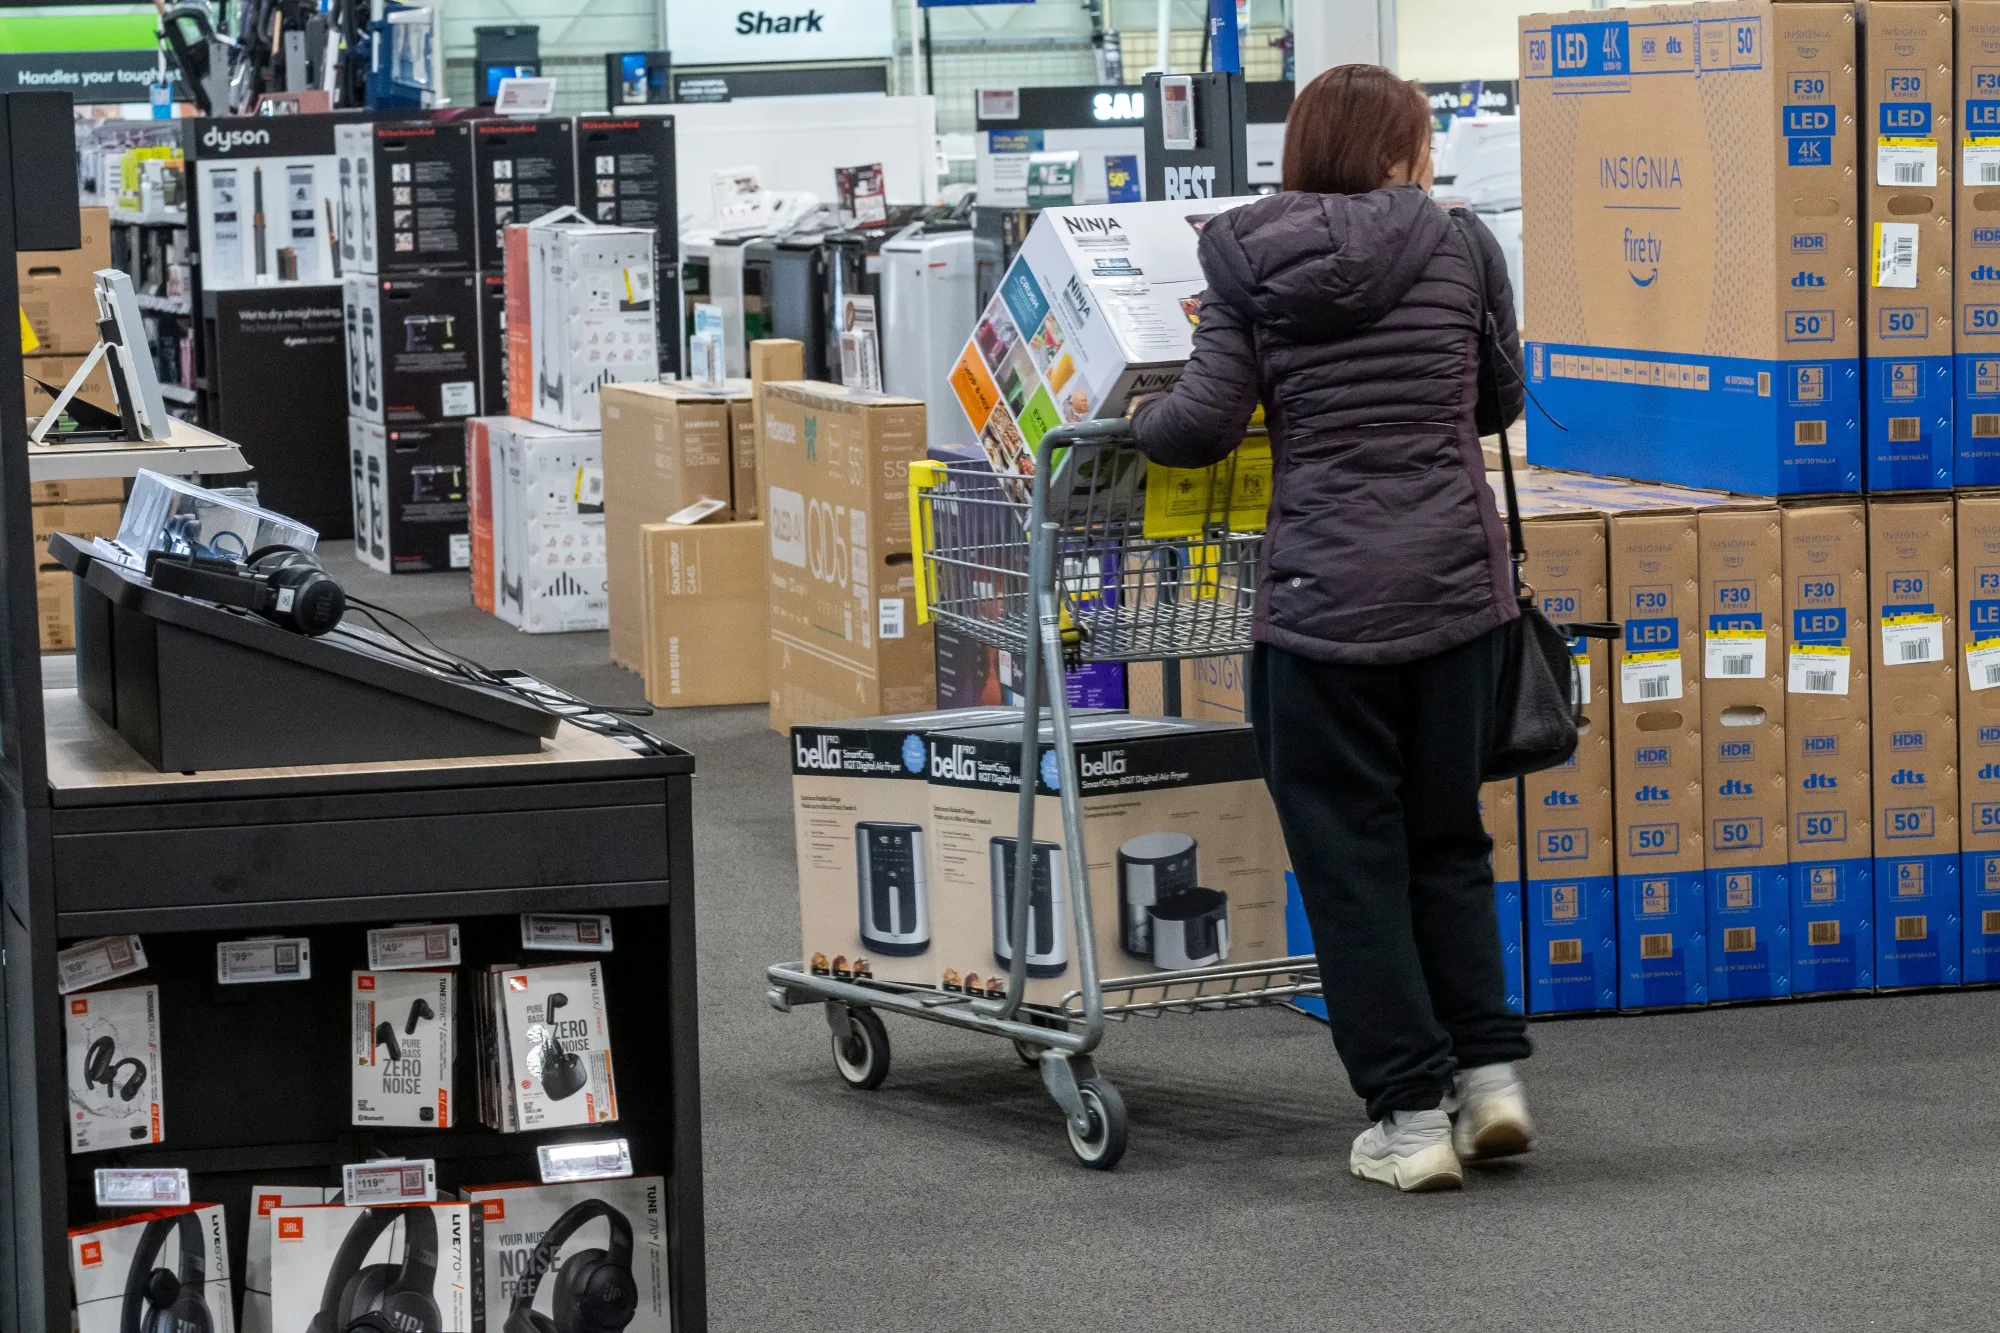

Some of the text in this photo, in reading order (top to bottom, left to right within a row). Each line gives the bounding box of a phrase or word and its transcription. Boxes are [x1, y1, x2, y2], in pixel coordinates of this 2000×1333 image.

[736, 9, 824, 35] Shark
[1968, 25, 2000, 34] INSIG
[1784, 30, 1832, 39] INSIGNIA
[1881, 28, 1928, 38] INSIGNIA
[1529, 39, 1547, 60] F30
[1557, 32, 1588, 69] LED
[1602, 28, 1621, 59] 4K
[1666, 36, 1683, 53] dts
[18, 68, 183, 87] Handles your toughst
[1890, 76, 1921, 91] F30
[1793, 79, 1824, 94] F30
[1477, 89, 1507, 107] ake
[1790, 112, 1829, 130] LED
[1887, 109, 1925, 127] LED
[203, 126, 270, 152] dyson
[1798, 141, 1822, 158] 4K
[1600, 155, 1683, 191] INSIGNIA
[1164, 166, 1216, 200] BEST
[1062, 215, 1122, 236] NINJA
[1793, 235, 1824, 249] HDR
[1791, 271, 1827, 287] dts
[1067, 274, 1091, 319] NINJA
[1800, 369, 1810, 383] 6
[1894, 366, 1904, 380] 6
[1977, 362, 1988, 376] 6
[1800, 386, 1815, 394] MAX
[807, 497, 849, 589] QD5
[1892, 578, 1923, 594] F30
[1980, 573, 2000, 588] F3
[1720, 587, 1751, 603] F30
[1804, 582, 1835, 597] F30
[1543, 597, 1575, 612] F30
[1635, 592, 1667, 608] F30
[1977, 606, 2000, 624] LE
[1801, 615, 1840, 633] LED
[1632, 625, 1672, 644] LED
[669, 637, 680, 695] SAMSUNG
[1191, 655, 1244, 691] INSIGN
[826, 735, 840, 744] PRO
[1892, 733, 1923, 746] HDR
[1979, 727, 2000, 741] HD
[962, 745, 976, 755] PRO
[1720, 743, 1751, 756] HDR
[1804, 737, 1836, 750] HDR
[795, 734, 842, 770] bella
[1636, 748, 1667, 762] HDR
[856, 761, 875, 773] Digital
[876, 763, 884, 771] Air
[884, 763, 901, 774] Fryer
[931, 742, 977, 781] bella
[1080, 751, 1127, 778] bella
[1136, 774, 1158, 785] Digital
[1159, 773, 1170, 782] Air
[1170, 771, 1190, 782] Fryer
[1890, 769, 1926, 785] dts
[1978, 763, 2000, 779] dt
[991, 774, 1011, 785] Digital
[1719, 779, 1753, 796] dts
[1802, 773, 1838, 789] dts
[1543, 790, 1580, 806] dts
[1635, 785, 1670, 801] dts
[1900, 866, 1910, 880] 6
[1987, 859, 1996, 873] 6
[1729, 876, 1739, 891] 6
[1812, 870, 1823, 884] 6
[1554, 888, 1564, 903] 6
[1645, 882, 1655, 897] 6
[590, 967, 600, 1008] TUNE FLEX
[526, 1004, 543, 1013] PURE
[527, 1014, 545, 1023] BASS
[552, 1019, 588, 1039] ZERO
[402, 1038, 421, 1048] PURE
[561, 1038, 590, 1052] NOISE
[402, 1048, 421, 1059] BASS
[382, 1058, 421, 1077] ZERO
[382, 1077, 421, 1095] NOISE
[647, 1185, 658, 1214] TUNE
[485, 1204, 501, 1215] JBL
[283, 1223, 299, 1233] JBL
[499, 1231, 549, 1246] YOUR MUS
[500, 1245, 562, 1278] NOISE
[501, 1279, 536, 1299] FREE
